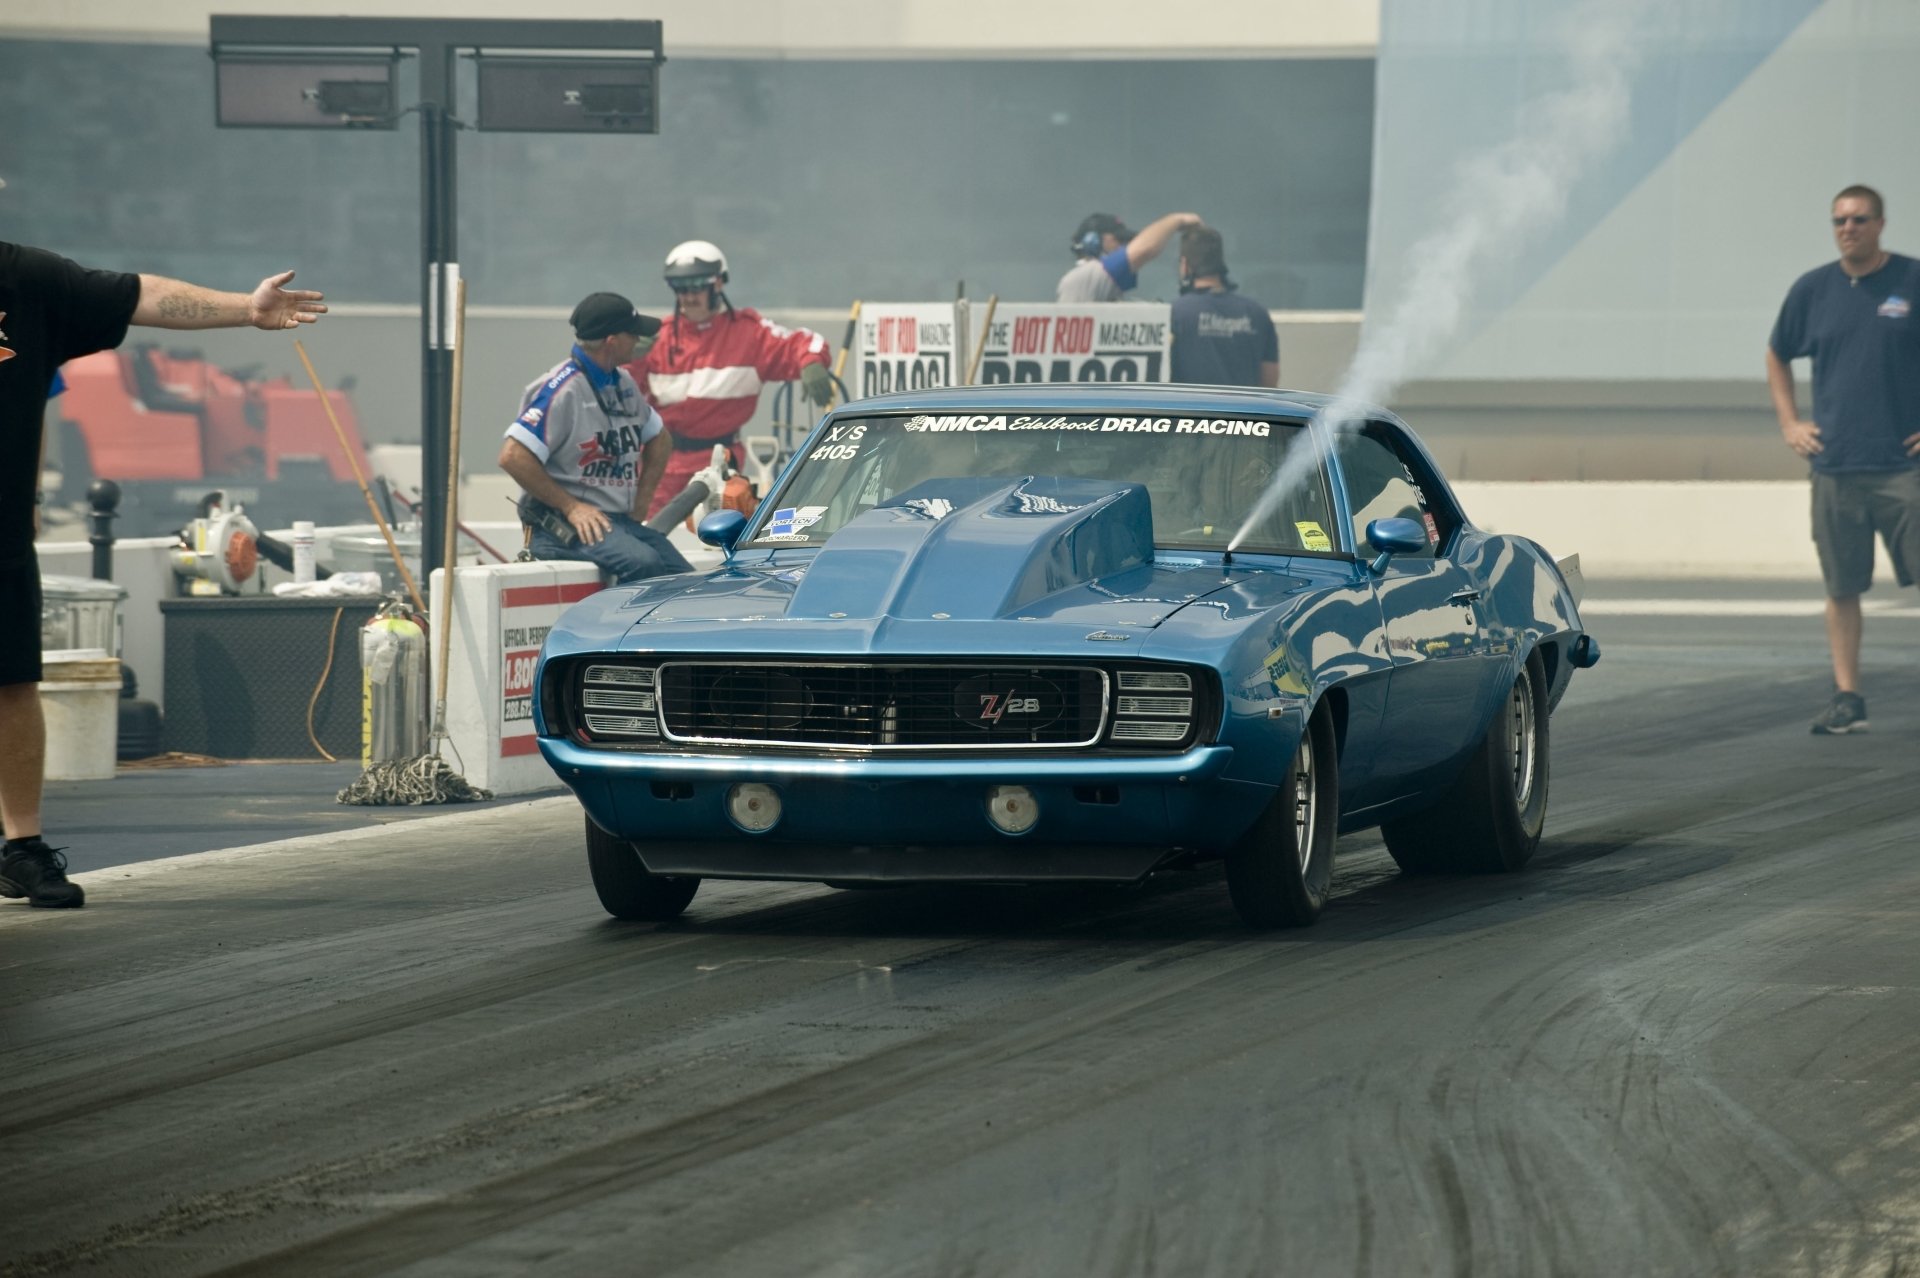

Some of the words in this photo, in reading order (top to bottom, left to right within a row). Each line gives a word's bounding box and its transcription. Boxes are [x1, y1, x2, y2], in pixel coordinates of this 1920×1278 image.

[878, 317, 895, 354] HOT
[898, 317, 917, 354] ROD
[985, 323, 1010, 346] THE
[1012, 317, 1051, 354] HOT
[1053, 317, 1095, 354] ROD
[1099, 323, 1166, 346] MAGAZINE
[824, 425, 868, 442] X/S
[919, 415, 1007, 432] NMCA
[1008, 416, 1100, 432] Edelbrock
[1100, 417, 1172, 433] DRAG
[1175, 419, 1271, 437] RACING
[808, 444, 860, 461] 4105
[504, 628, 528, 648] OFFICIAL
[980, 688, 1040, 724] Z/28
